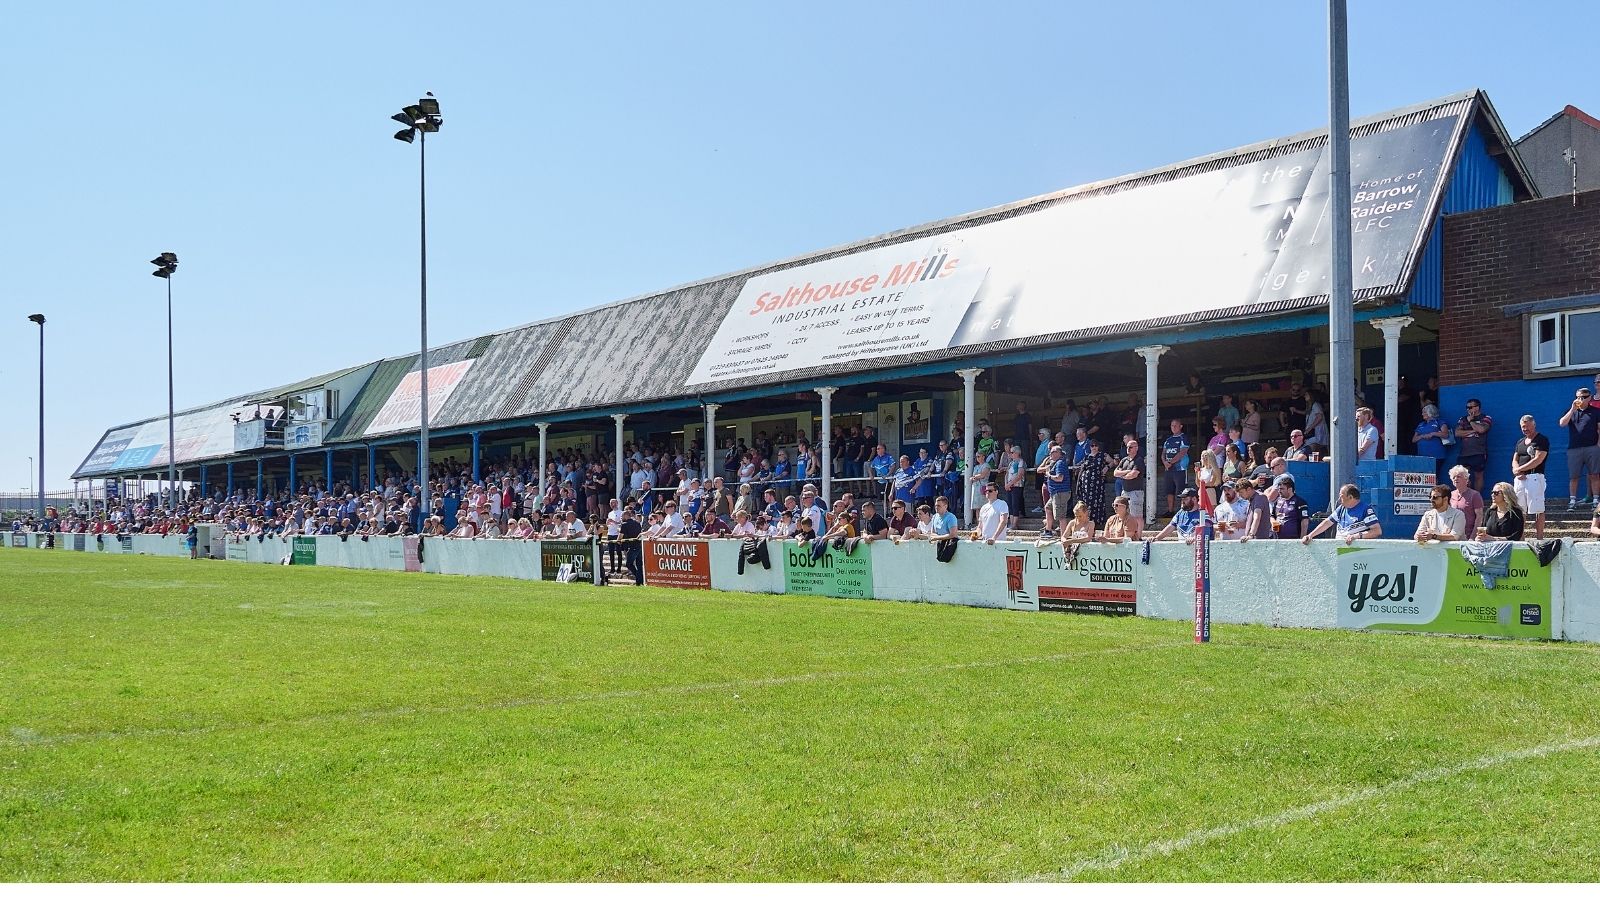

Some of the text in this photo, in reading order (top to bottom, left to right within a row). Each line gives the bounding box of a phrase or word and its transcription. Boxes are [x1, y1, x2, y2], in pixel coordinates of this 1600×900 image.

[1262, 165, 1302, 184] the
[1359, 169, 1424, 190] Home of
[1353, 182, 1418, 204] Barrow
[1350, 199, 1413, 220] Raiders
[750, 253, 960, 316] Salthouse Mills
[771, 292, 904, 325] INDUSTRIAL ESTATE
[854, 304, 924, 322] EASY IN OUT TERMS
[813, 318, 841, 329] ACCESS
[846, 325, 872, 336] LEASES
[873, 323, 884, 331] UP
[906, 316, 931, 326] YEARS
[735, 331, 770, 344] WORKSHOPS
[791, 337, 808, 345] CCTV
[821, 350, 851, 360] managed
[899, 341, 915, 351] (UK)
[915, 339, 930, 348] Ltd
[653, 543, 698, 557] LONGLANE
[543, 553, 585, 569] THINK HSP
[658, 557, 693, 572] GARAGE
[835, 557, 867, 565] Takeaway
[1353, 562, 1368, 571] SAY
[836, 568, 867, 576] Deliveries
[1091, 574, 1131, 583] SOLICITORS
[836, 579, 861, 587] Outside
[1348, 565, 1418, 613] yes!
[838, 588, 864, 597] Catering
[1369, 604, 1420, 615] TO SUCCESS
[1455, 605, 1497, 616] FURNESS
